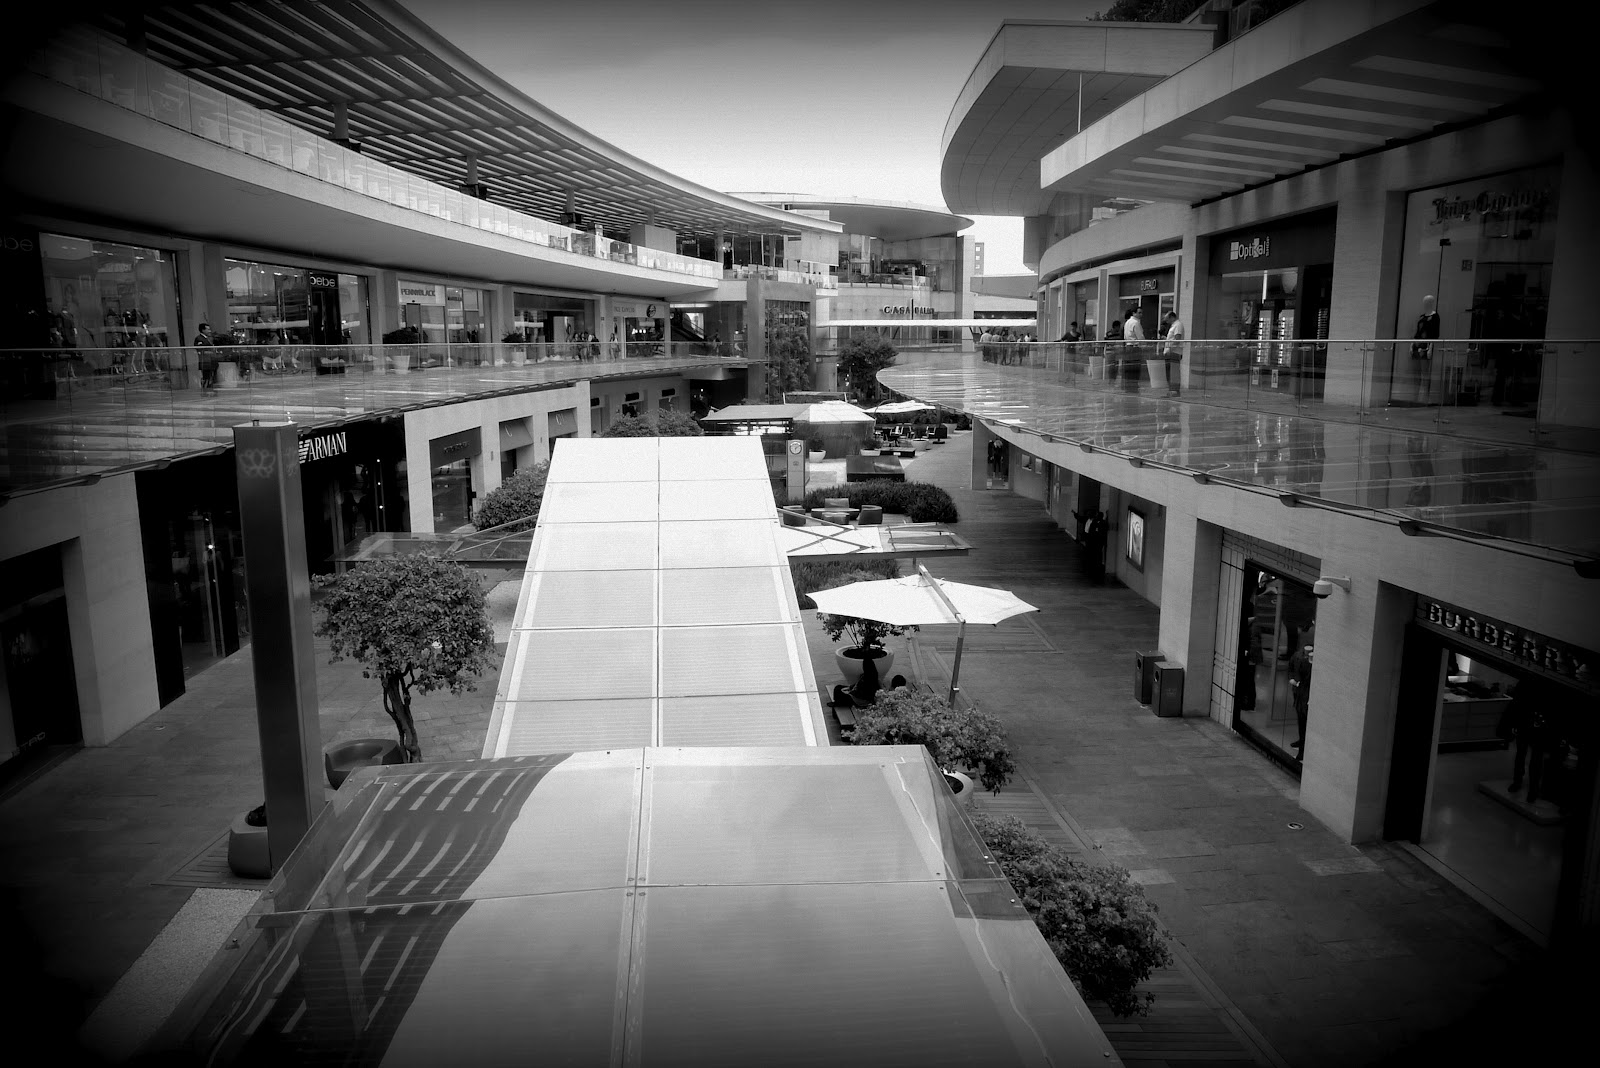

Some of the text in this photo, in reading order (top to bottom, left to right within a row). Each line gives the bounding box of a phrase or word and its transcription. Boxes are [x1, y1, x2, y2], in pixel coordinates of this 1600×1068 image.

[0, 233, 33, 252] be
[883, 306, 911, 315] CASA
[308, 432, 348, 462] ARMANI
[1425, 603, 1592, 680] BURBERRY
